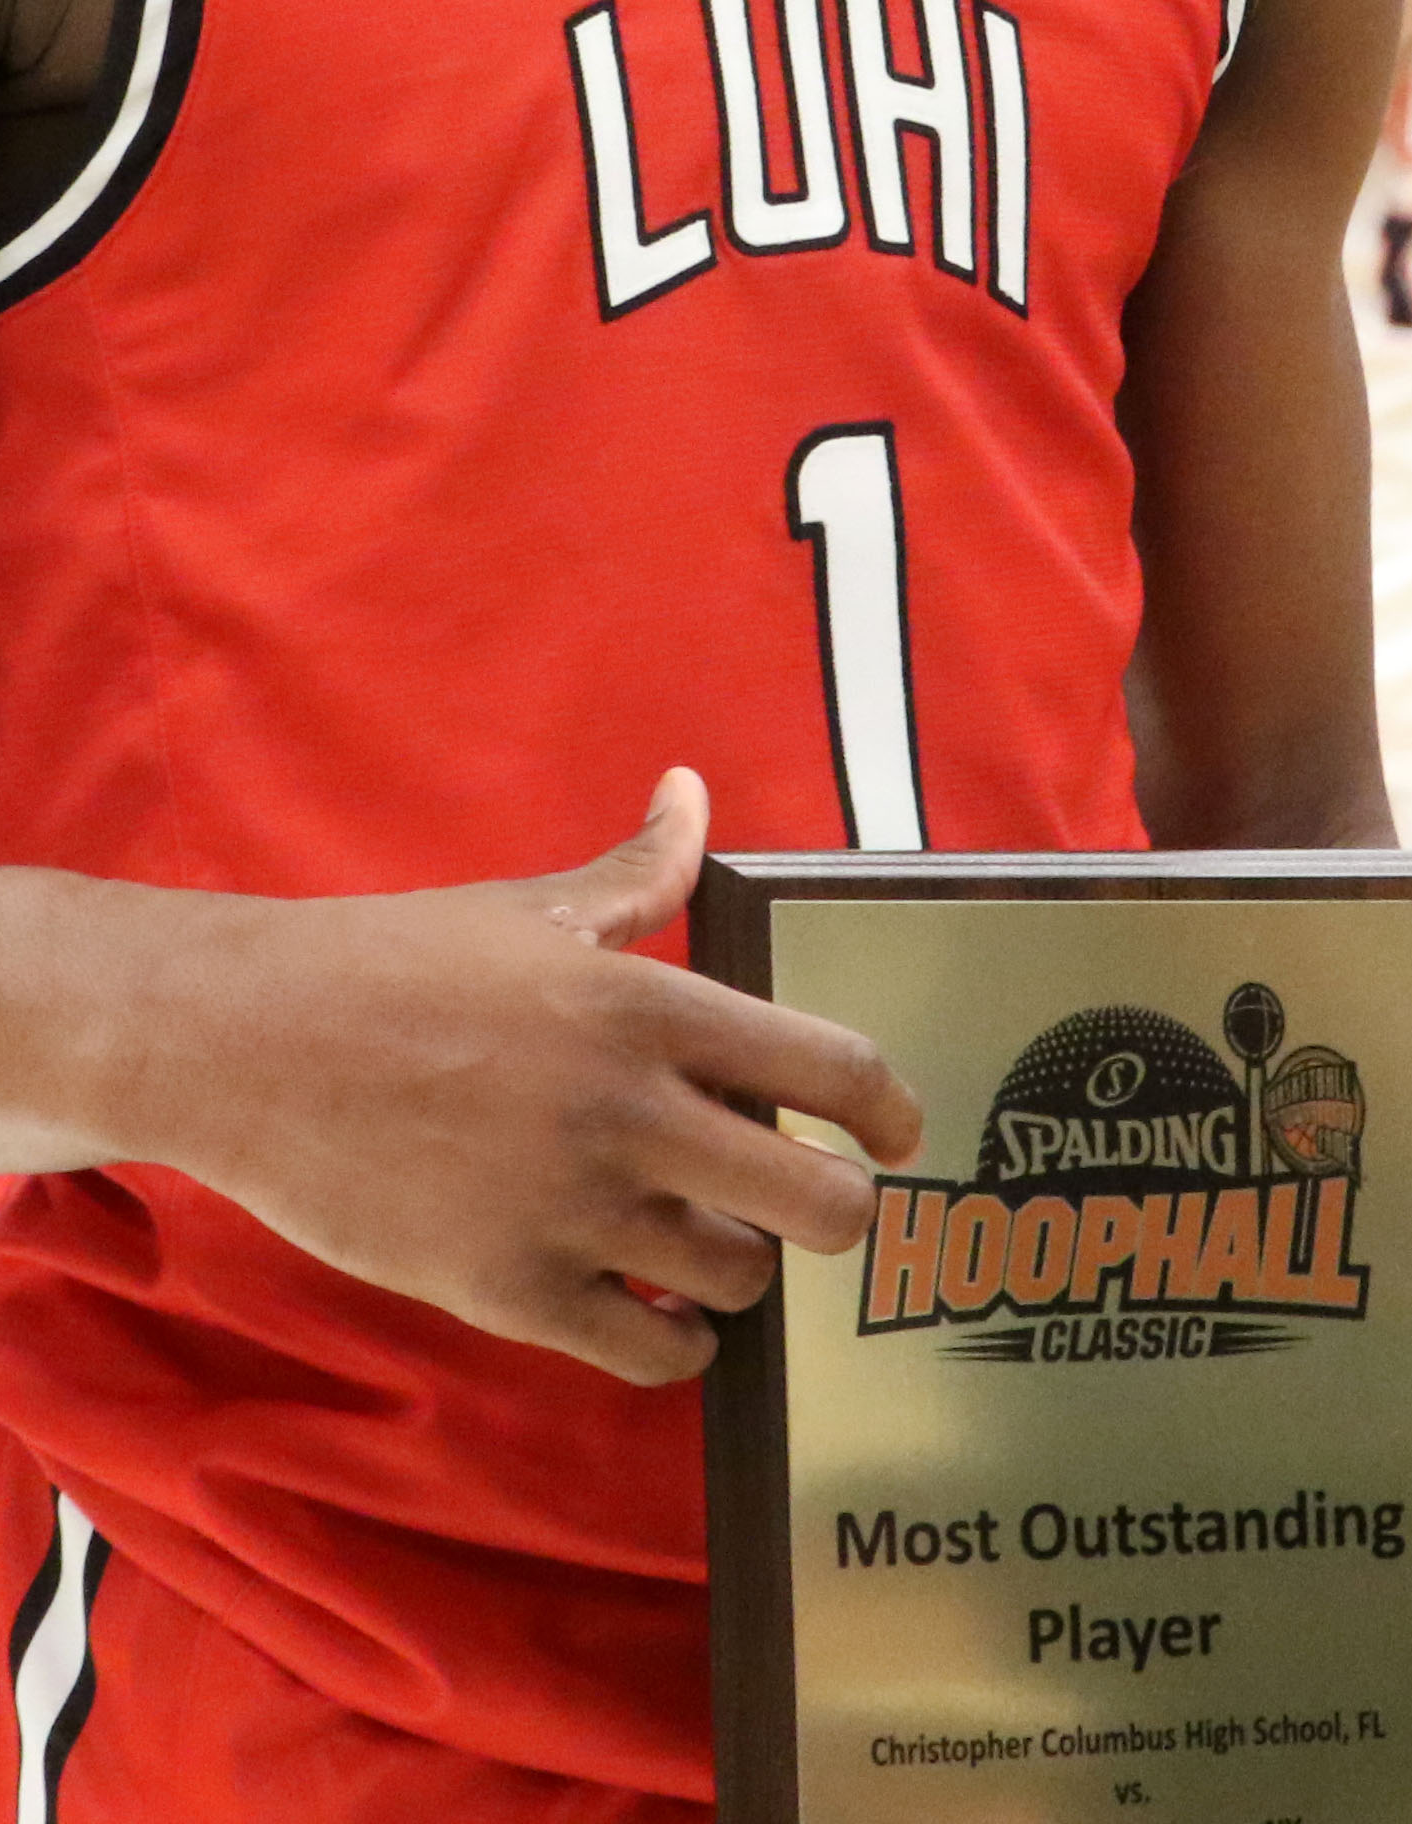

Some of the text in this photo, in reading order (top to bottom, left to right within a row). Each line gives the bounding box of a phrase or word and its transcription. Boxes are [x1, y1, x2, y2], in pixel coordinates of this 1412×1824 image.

[787, 421, 931, 850] 1
[997, 1105, 1236, 1181] SPALDING
[859, 1176, 1370, 1334] HOOPHALL
[1041, 1315, 1209, 1362] CLASSIC
[837, 1490, 1405, 1569] Most Outstanding
[1028, 1604, 1221, 1673] Player
[872, 1711, 1386, 1768] Christopher Columbus High School, FL
[1114, 1782, 1151, 1805] vs.
